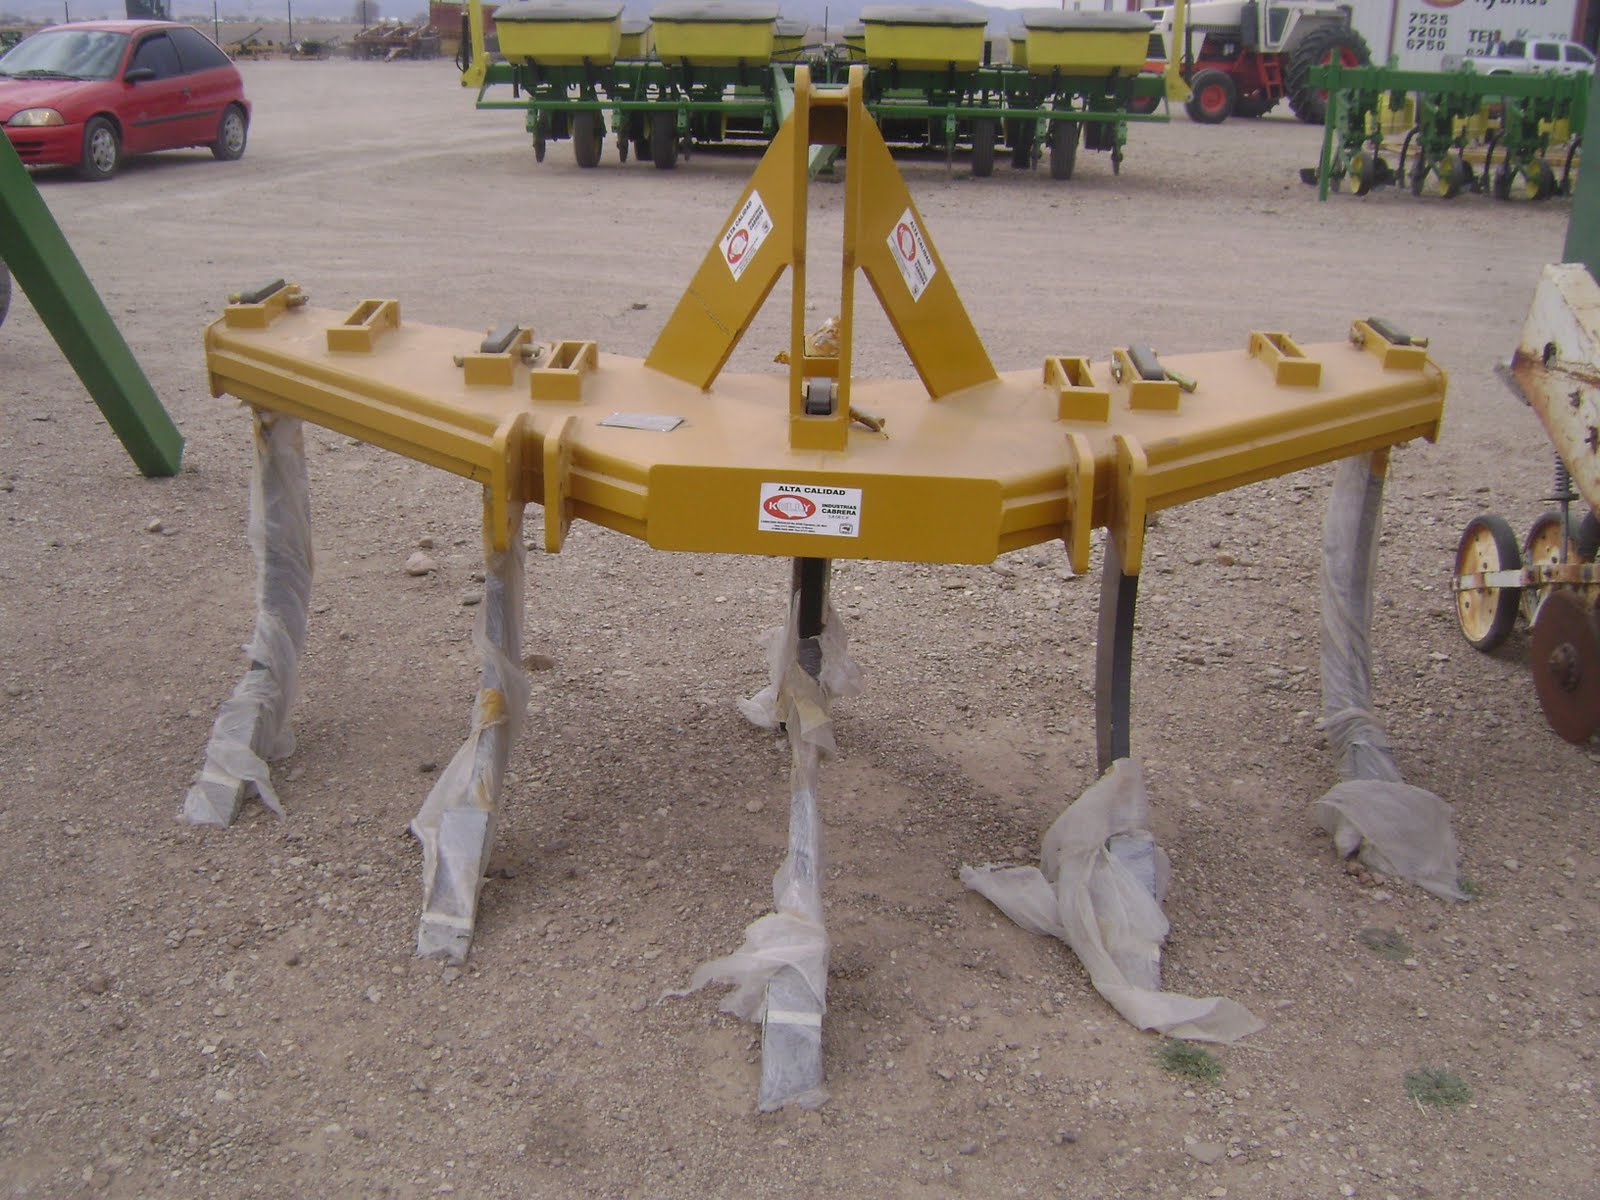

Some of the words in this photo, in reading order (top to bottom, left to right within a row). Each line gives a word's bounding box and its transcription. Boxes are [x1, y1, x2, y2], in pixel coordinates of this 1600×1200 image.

[1409, 12, 1448, 26] 7525
[1408, 26, 1447, 39] 7200
[1406, 38, 1445, 51] 6750
[778, 485, 801, 493] ALTA
[804, 487, 846, 496] CALIDAD
[821, 503, 857, 511] INDUSTRIAS
[821, 508, 857, 516] CABRERA
